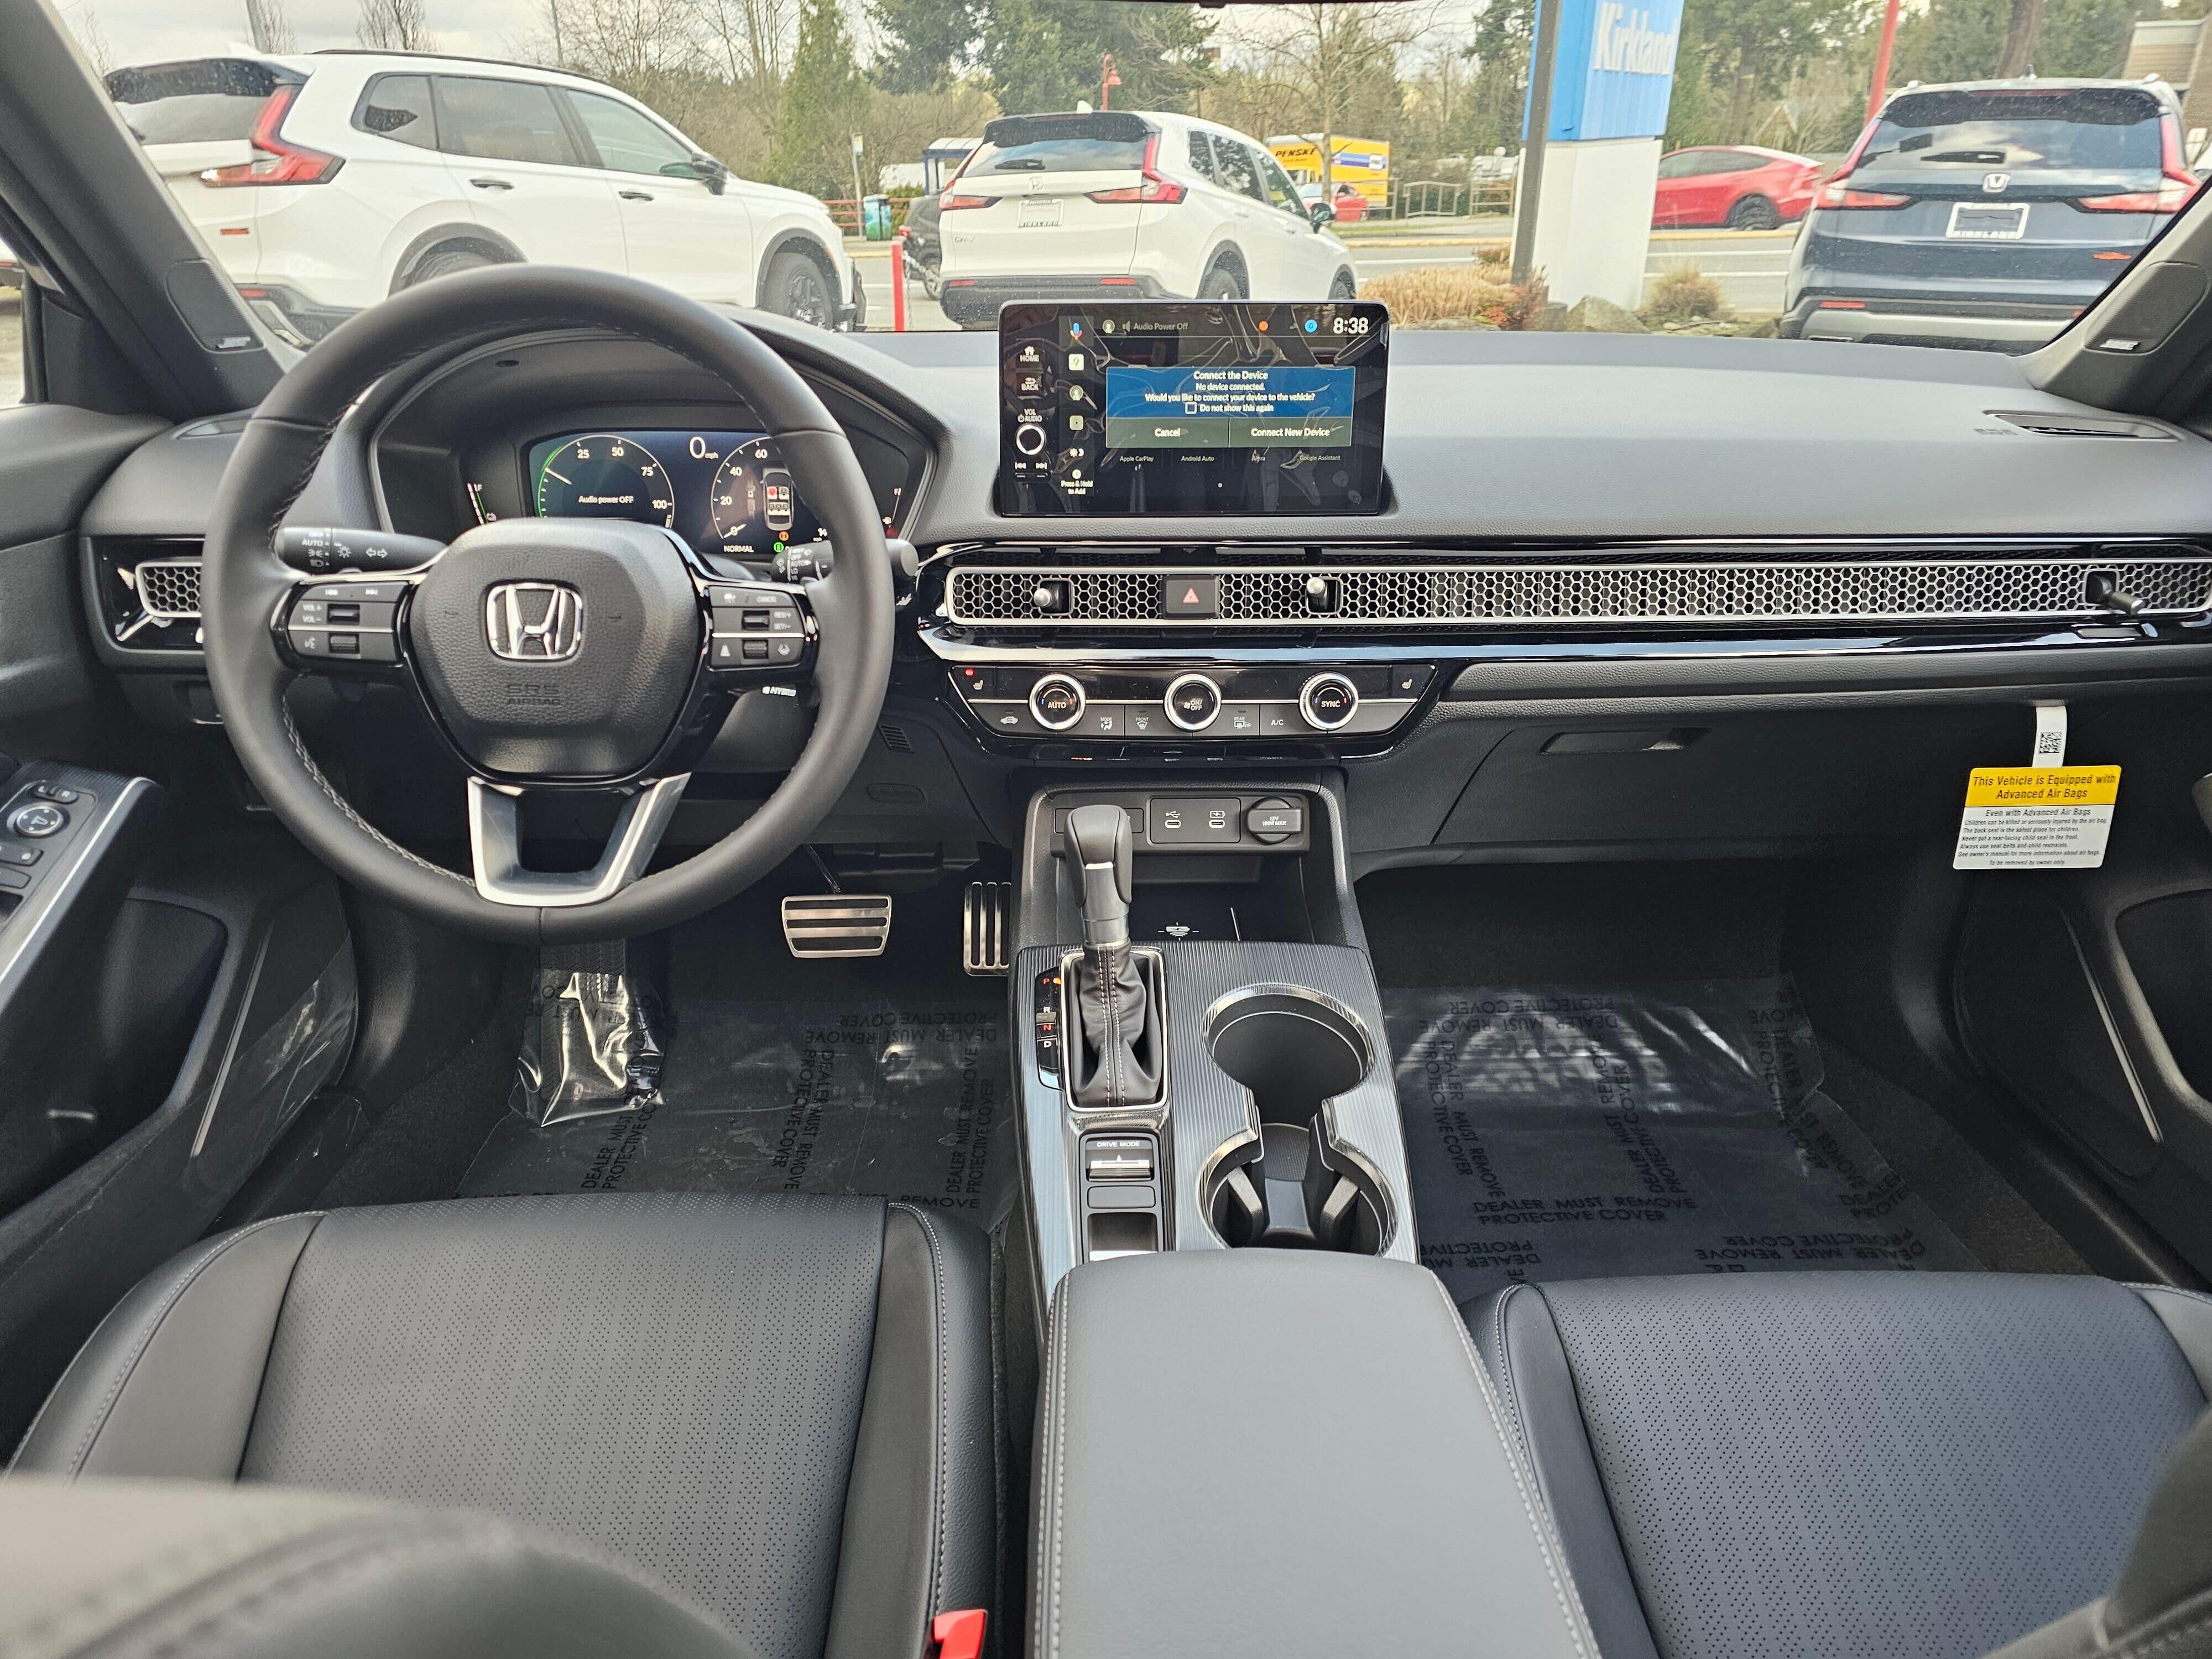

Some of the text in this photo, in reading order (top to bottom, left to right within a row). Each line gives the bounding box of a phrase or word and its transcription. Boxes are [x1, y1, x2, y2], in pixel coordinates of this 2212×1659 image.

[1593, 2, 1679, 76] Kirkland
[1275, 147, 1318, 158] PENSKE
[1333, 317, 1369, 334] 8:38
[1193, 371, 1269, 380] Connect the Device
[1196, 382, 1266, 391] No device connected.
[1145, 393, 1167, 401] Would
[1168, 394, 1181, 403] you
[1181, 393, 1193, 401] like
[1230, 394, 1245, 403] your
[1245, 393, 1267, 401] device
[1268, 393, 1276, 401] to
[1276, 393, 1288, 401] the
[1289, 393, 1316, 401] vehicle?
[1199, 404, 1274, 413] Do not show this again
[1154, 427, 1181, 437] Cancel
[1251, 427, 1331, 437] Connect New Device
[611, 447, 624, 457] 50
[689, 436, 718, 460] 0 mph
[577, 449, 590, 460] 25
[754, 448, 768, 460] 60
[641, 466, 654, 477] 75
[729, 466, 742, 477] 40
[578, 495, 634, 505] Audio power OFF
[651, 499, 667, 509] 100
[720, 495, 732, 505] 20
[818, 527, 828, 537] 14
[302, 539, 324, 547] AUTO
[723, 545, 754, 554] NORMAL
[507, 684, 560, 696] SRS
[1974, 774, 2116, 786] This Vehicle is Equipped with
[1996, 788, 2088, 799] Advanced Air Bags
[2073, 808, 2091, 816] Bags
[839, 1014, 895, 1027] COVER
[805, 1027, 996, 1045] DEALER MUST REMOVE
[1044, 1040, 1052, 1048] D
[1425, 1041, 1473, 1176] PROTECTIVE COVER
[946, 1047, 978, 1193] DEALER MUST REMOVE
[1441, 1040, 1506, 1197] DEALER MUST REMOVE
[966, 1077, 994, 1194] PROTECTIVE COVER
[1473, 1194, 1698, 1213] DEALER MUST REMOVE
[1479, 1208, 1668, 1226] PROTECTIVE COVER
